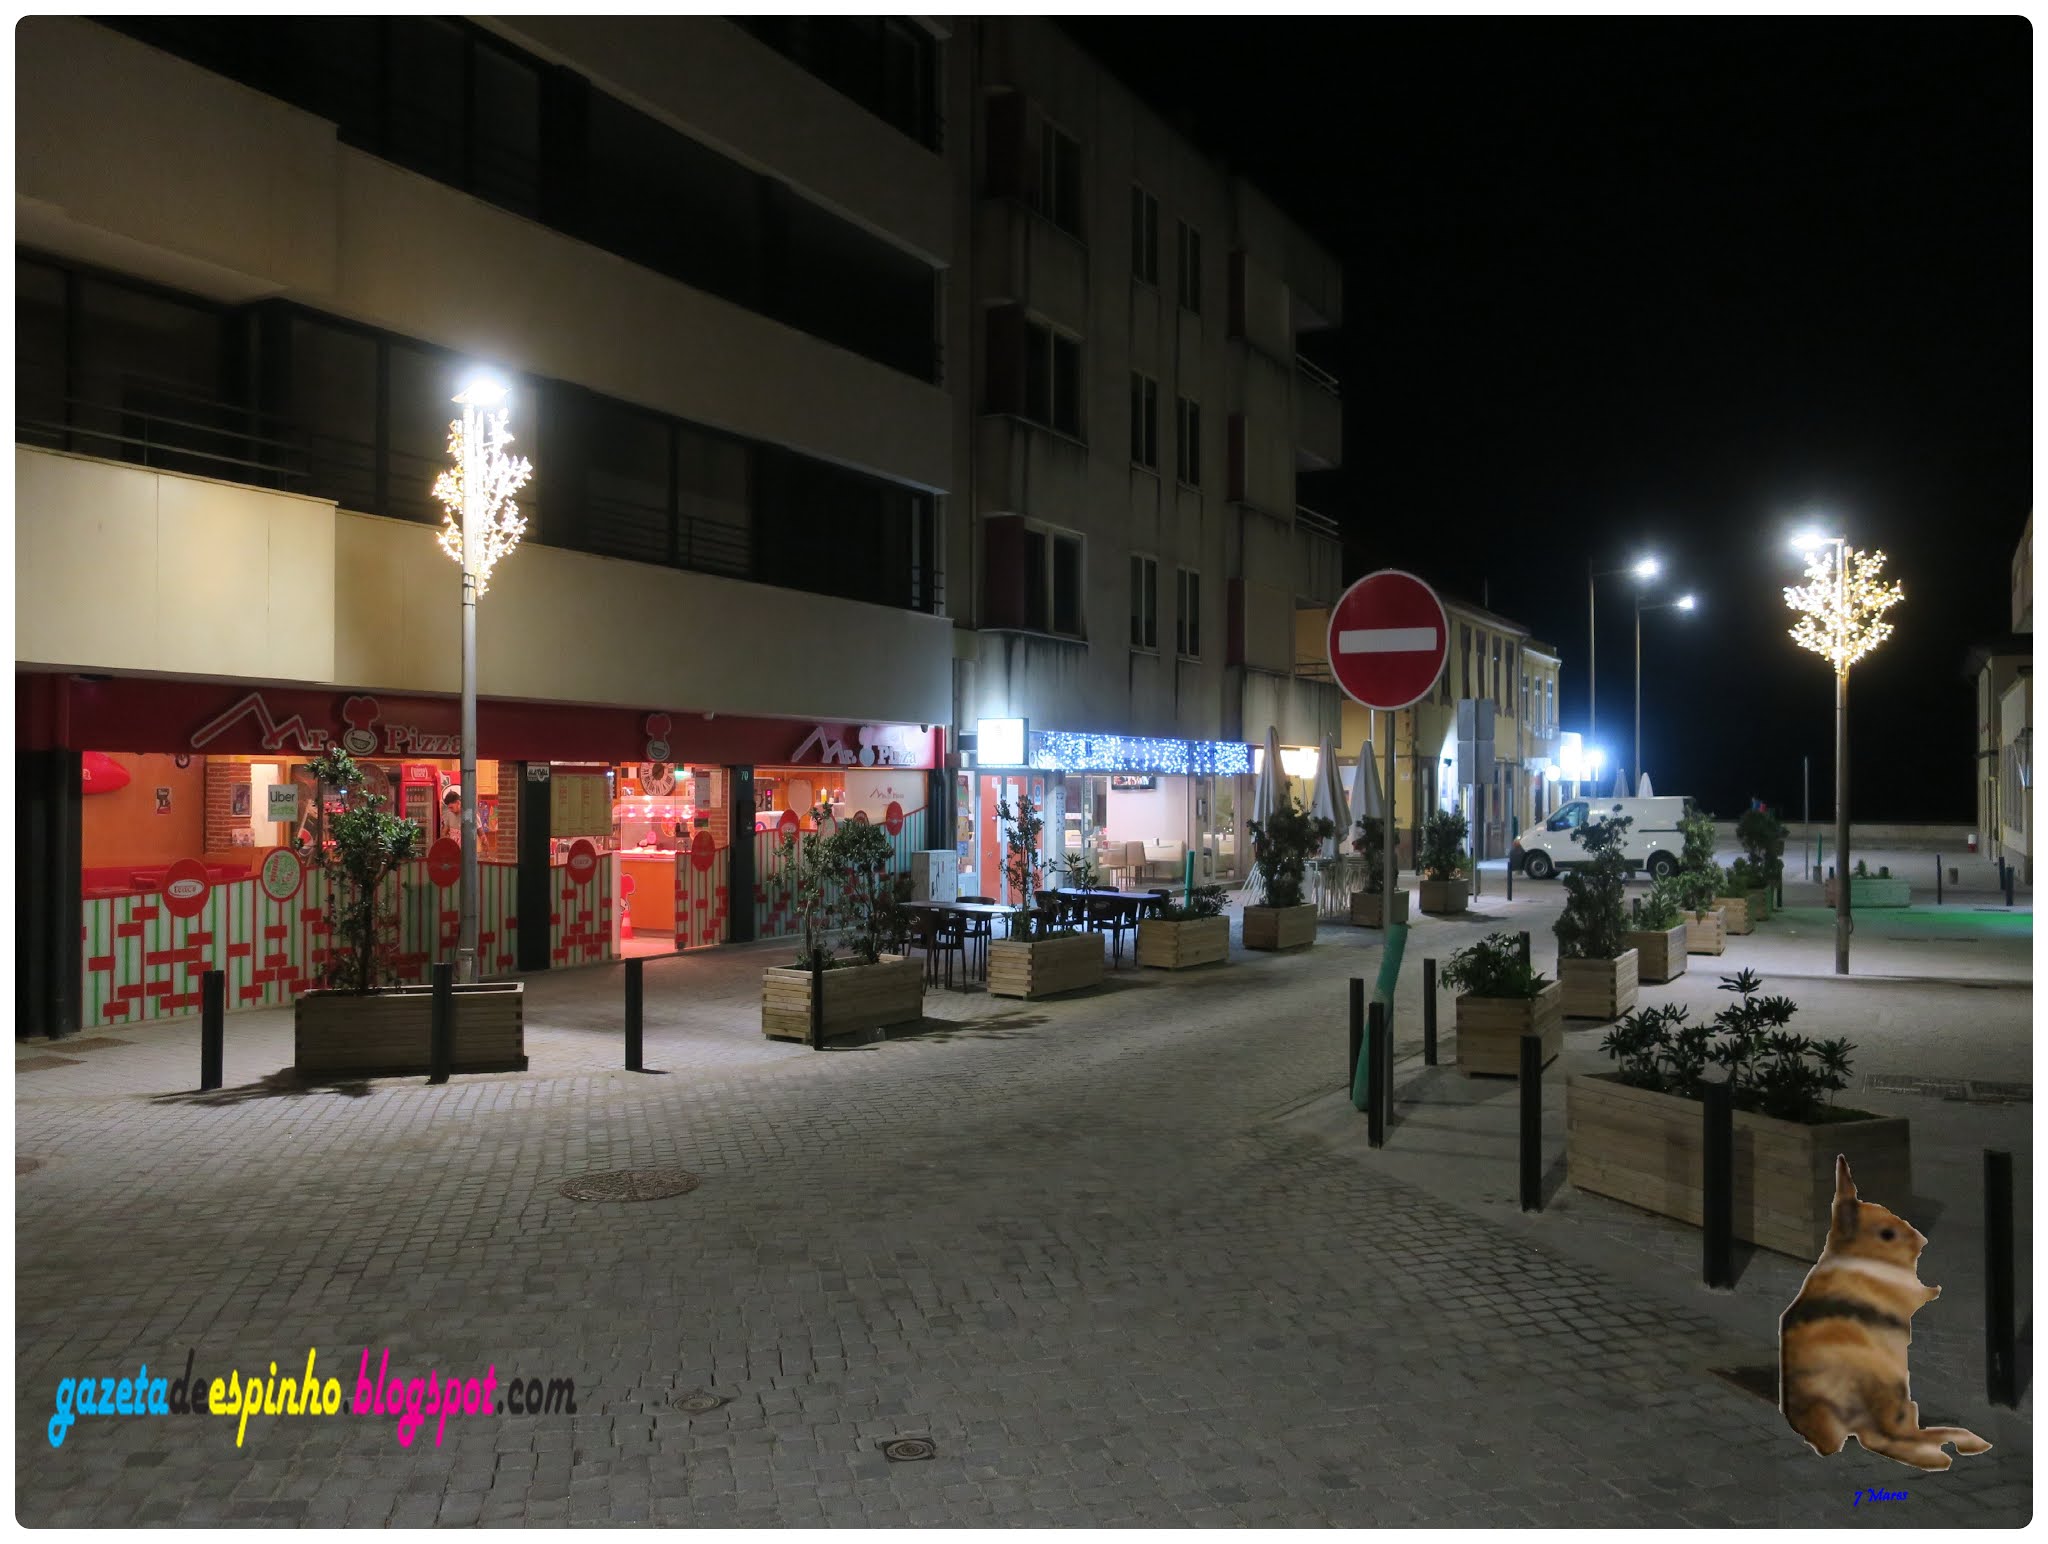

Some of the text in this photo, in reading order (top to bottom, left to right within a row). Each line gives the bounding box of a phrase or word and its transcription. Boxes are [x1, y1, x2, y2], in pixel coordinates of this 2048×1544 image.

[191, 692, 337, 751] Mr.
[740, 770, 749, 781] 70
[270, 791, 295, 802] Uber
